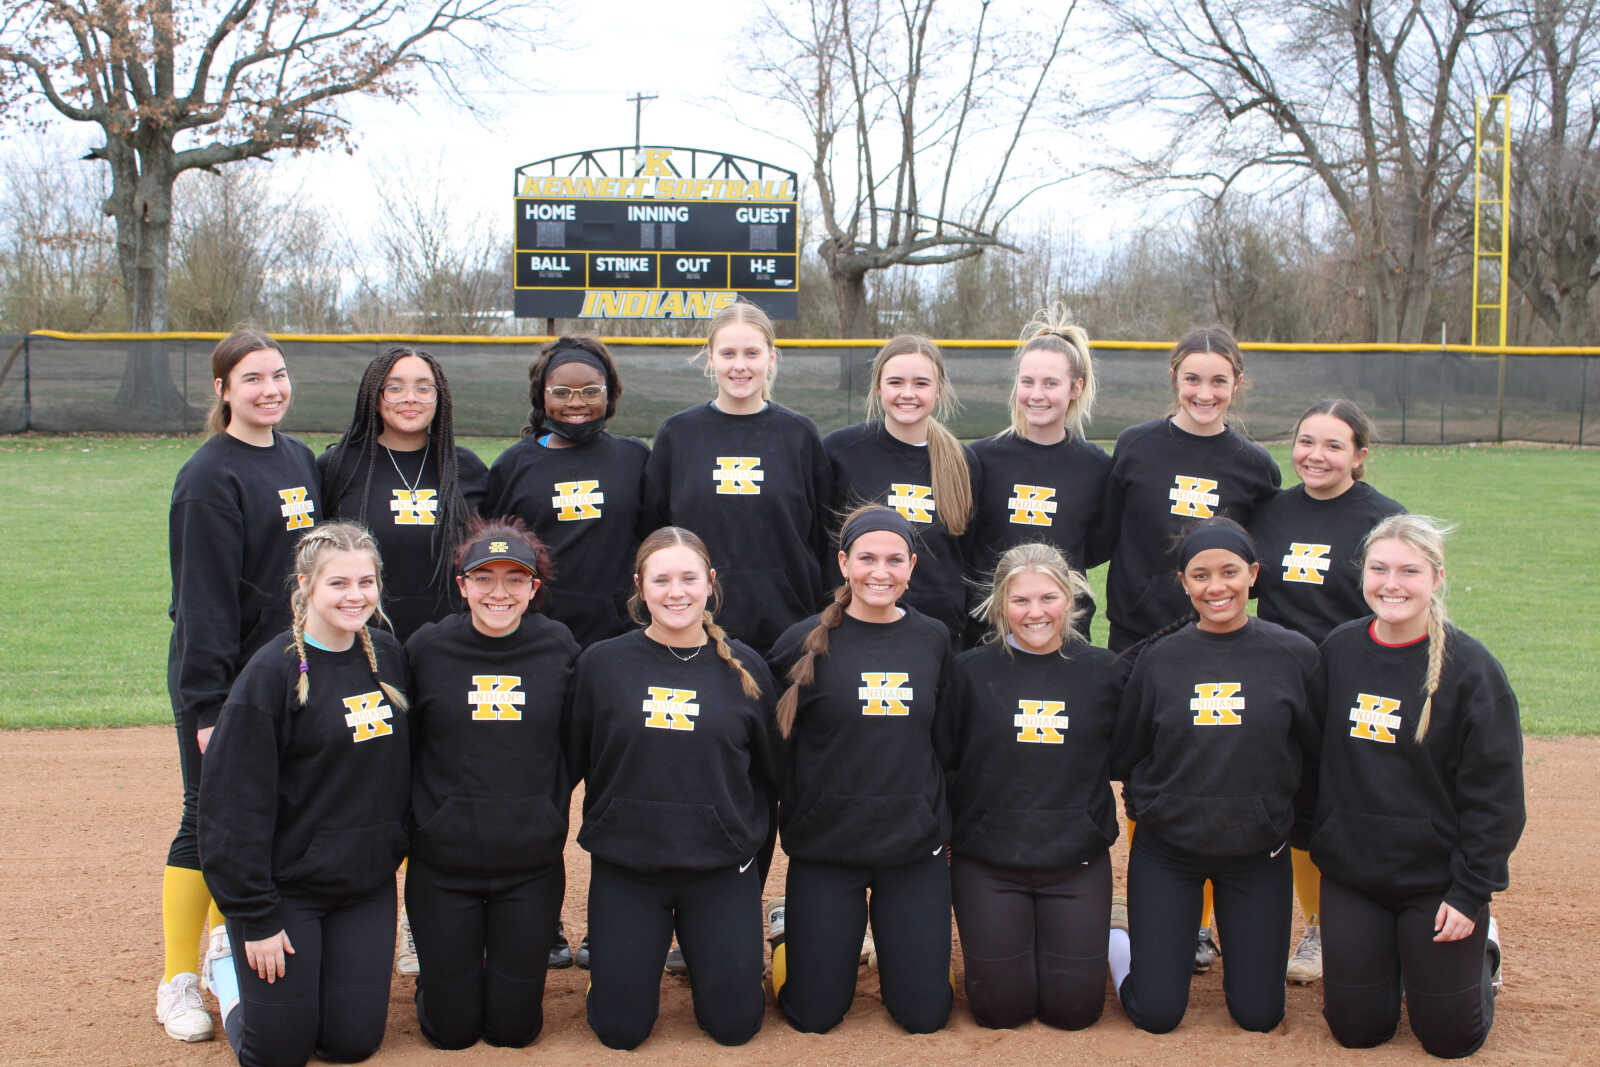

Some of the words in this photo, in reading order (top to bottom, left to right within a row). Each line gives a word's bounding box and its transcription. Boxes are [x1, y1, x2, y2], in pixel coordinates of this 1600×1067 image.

[643, 149, 673, 177] K
[521, 176, 650, 197] KENNETT
[654, 178, 796, 200] SOFTBALL
[525, 204, 576, 220] HOME
[628, 206, 689, 222] INNING
[735, 207, 790, 223] GUEST
[531, 257, 570, 270] BALL
[596, 258, 649, 271] STRIKE
[676, 258, 711, 272] OUT
[579, 290, 738, 318] INDIANS
[716, 457, 760, 494] K
[278, 486, 314, 531] K
[392, 489, 437, 524] K
[555, 480, 601, 521] K
[891, 483, 933, 523] K
[1010, 484, 1056, 526] K
[1170, 475, 1218, 519] K
[1282, 543, 1331, 584] K
[469, 692, 524, 704] INDIANS
[471, 675, 522, 721] K
[645, 687, 696, 731] K
[861, 672, 909, 716] K
[1194, 682, 1241, 726] K
[342, 690, 393, 743] K
[1015, 715, 1068, 728] INDIANS
[1017, 700, 1065, 744] K
[1349, 693, 1401, 743] K
